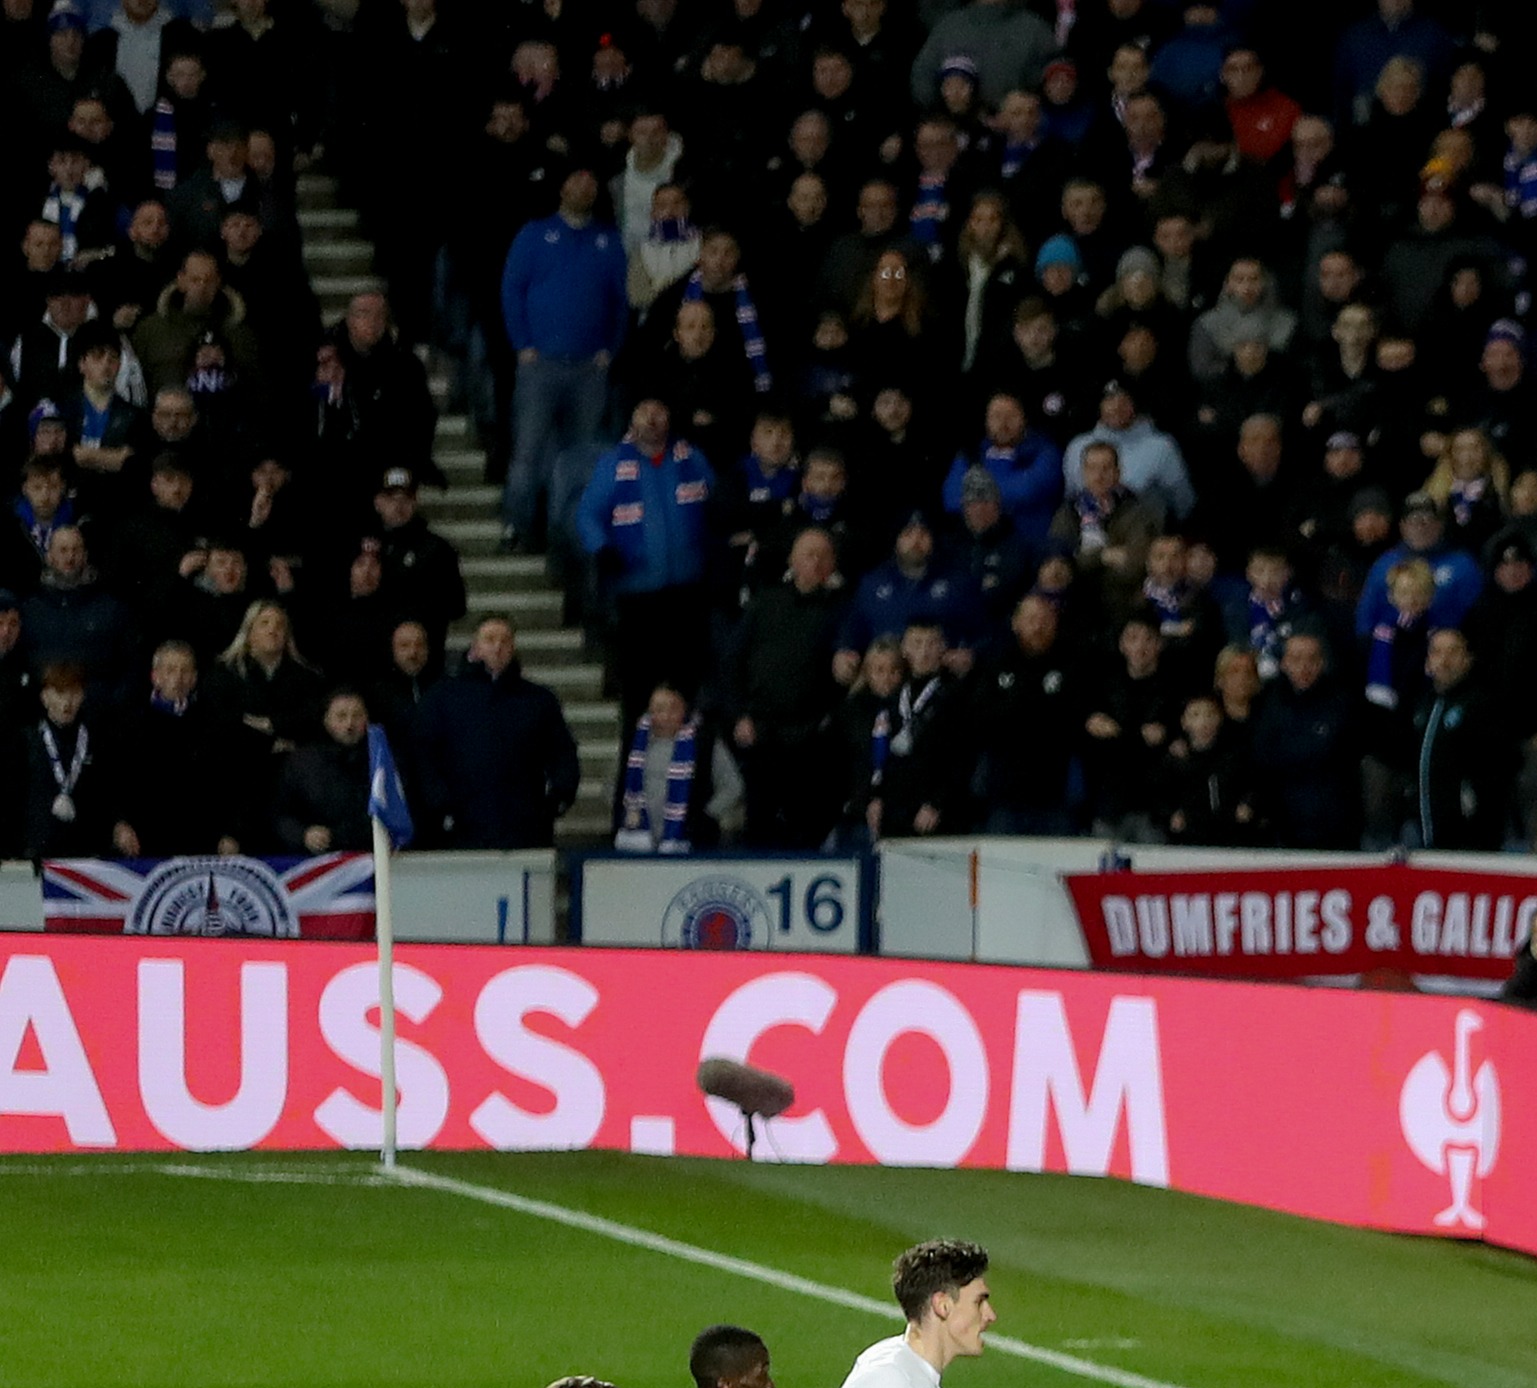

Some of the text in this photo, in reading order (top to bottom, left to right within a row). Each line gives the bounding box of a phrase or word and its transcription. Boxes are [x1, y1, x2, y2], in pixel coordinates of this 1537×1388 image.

[766, 874, 845, 932] 16
[1102, 888, 1352, 959] DUMFRIES
[1366, 894, 1399, 951] &
